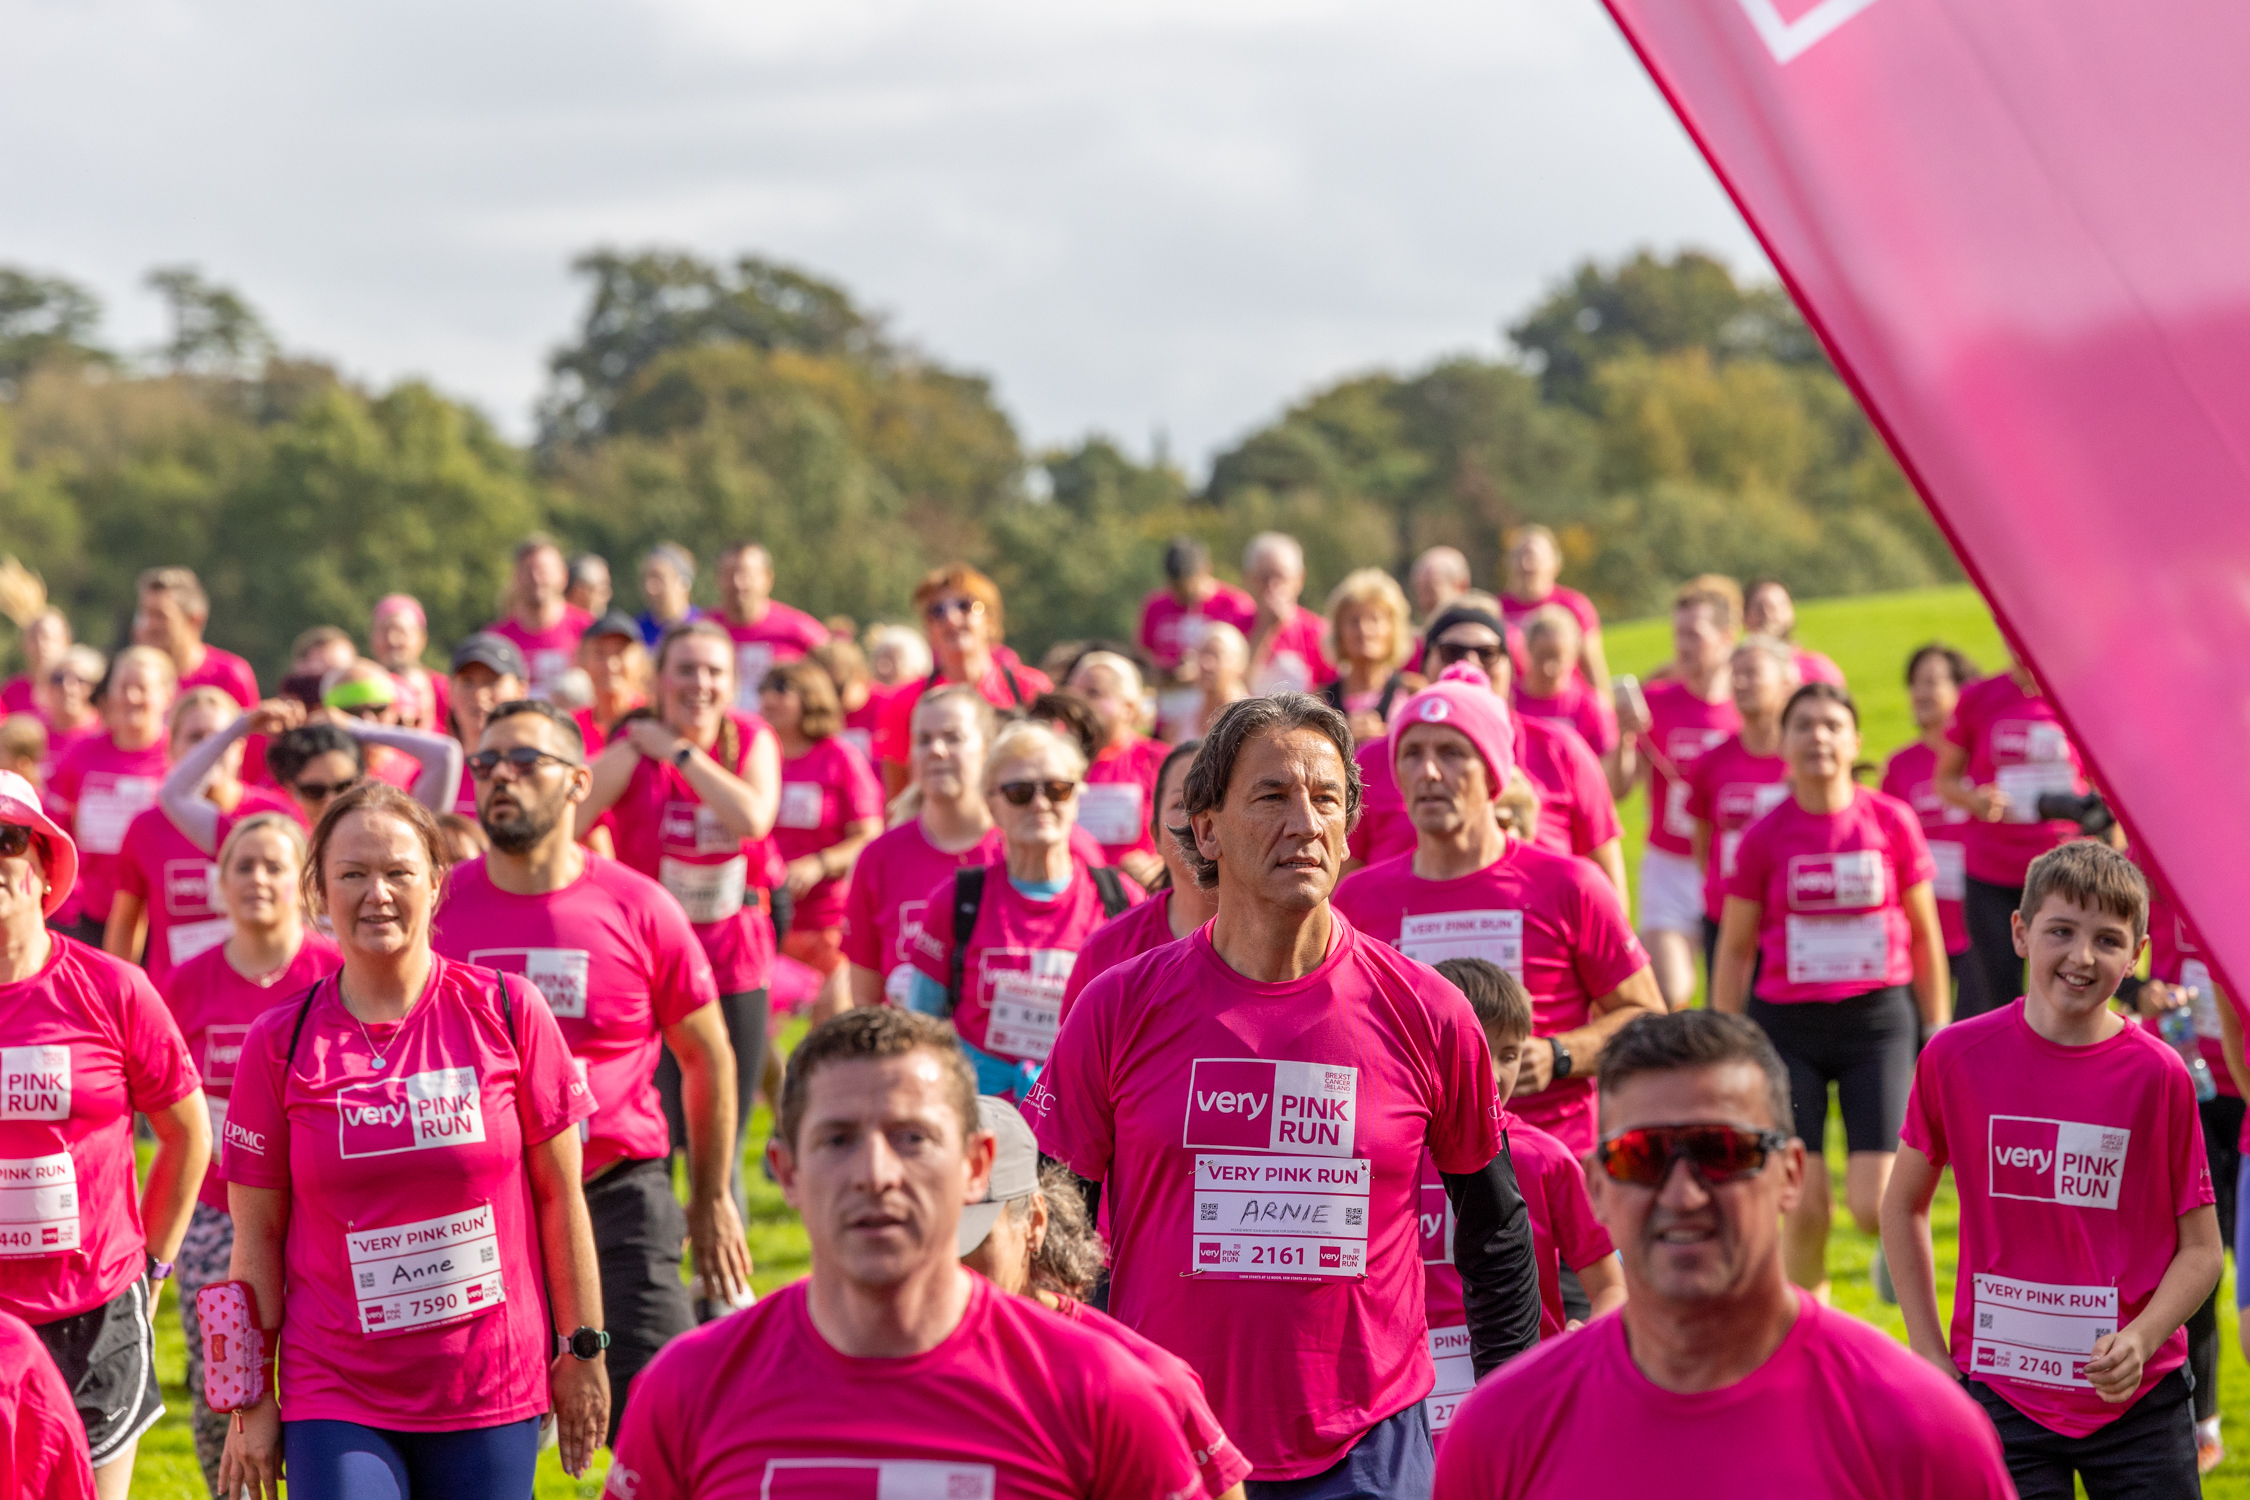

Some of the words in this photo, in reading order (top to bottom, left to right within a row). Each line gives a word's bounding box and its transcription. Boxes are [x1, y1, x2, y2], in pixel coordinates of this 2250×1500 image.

[8, 1073, 64, 1091] PINK
[8, 1094, 58, 1112] RUN
[345, 1102, 406, 1128] very
[417, 1092, 475, 1117] PINK
[1197, 1091, 1268, 1121] very
[1281, 1095, 1349, 1122] PINK
[225, 1120, 265, 1150] UPMC
[421, 1115, 472, 1139] RUN
[1279, 1120, 1340, 1146] RUN
[36, 1164, 66, 1178] RUN
[1995, 1145, 2053, 1175] very
[2062, 1152, 2120, 1178] PINK
[1208, 1166, 1260, 1181] VERY
[1265, 1167, 1312, 1183] PINK
[1317, 1169, 1358, 1184] RUN
[2061, 1175, 2109, 1199] RUN
[1240, 1200, 1332, 1225] ARNIE
[358, 1234, 402, 1252] VERY
[406, 1226, 448, 1245] PINK
[451, 1216, 484, 1236] RUN
[1420, 1213, 1443, 1239] ry
[1200, 1250, 1219, 1258] very
[1251, 1246, 1304, 1265] 2161
[1321, 1253, 1339, 1261] very
[392, 1259, 454, 1285] Anne
[410, 1293, 457, 1317] 7590
[1985, 1282, 2022, 1299] VERY
[2027, 1290, 2065, 1306] PINK
[2070, 1295, 2107, 1308] RUN
[2019, 1356, 2062, 1376] 2740
